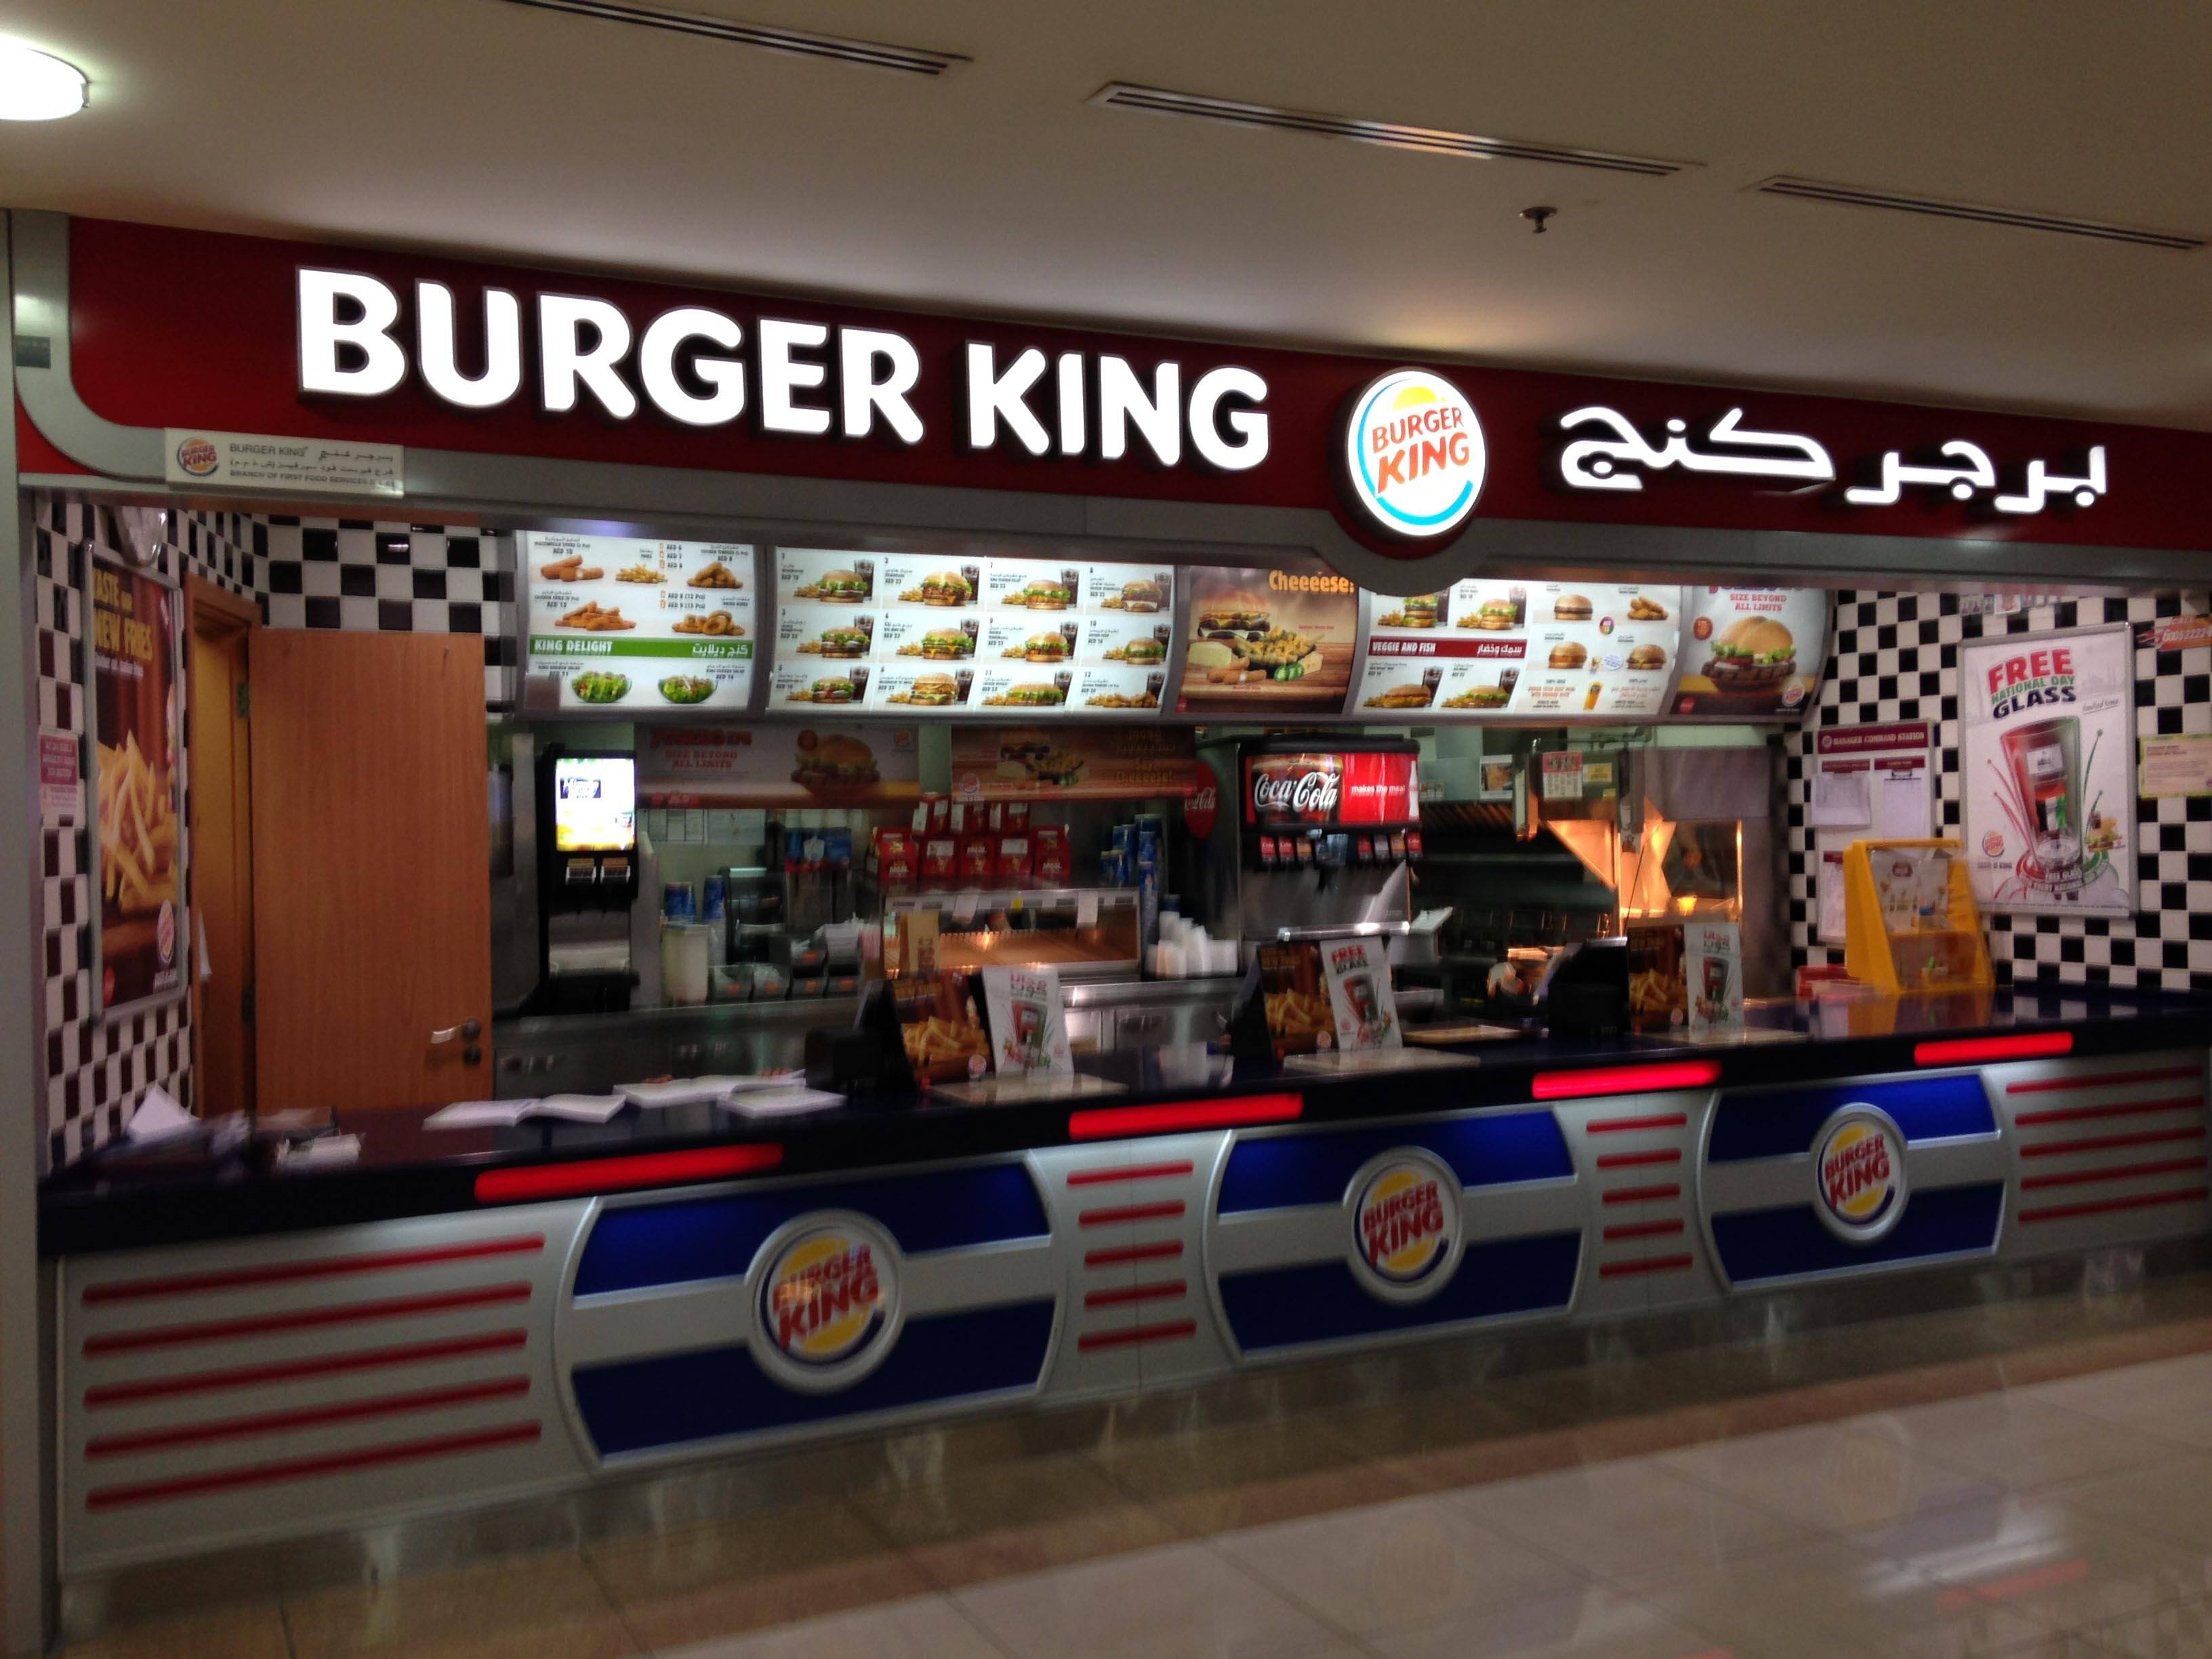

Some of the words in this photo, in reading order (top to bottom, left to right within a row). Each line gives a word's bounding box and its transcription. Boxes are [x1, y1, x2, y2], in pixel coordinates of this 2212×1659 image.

[299, 268, 924, 443] BURGER
[968, 342, 1269, 470] KING
[1372, 407, 1463, 453] BURGER
[182, 445, 215, 457] BURGER
[182, 451, 218, 468] KING
[229, 443, 276, 455] BURGER
[1378, 432, 1469, 493] KING
[1559, 406, 1835, 490] كنج
[1845, 440, 2107, 513] برجر
[1730, 593, 1749, 601] SIZE
[1751, 594, 1788, 602] BEYOND
[1735, 602, 1751, 611] ALL
[1754, 603, 1783, 612] LIMITS
[96, 609, 121, 652] NEW
[124, 617, 152, 661] FRIES
[534, 639, 563, 651] KING
[566, 640, 613, 653] DELIGHT
[1372, 641, 1399, 652] VEGGIE
[1401, 642, 1418, 653] AND
[1418, 642, 1437, 653] FISH
[1988, 648, 2074, 695] FREE
[1991, 678, 2047, 705] NATIONAL
[2051, 675, 2076, 686] DAY
[1992, 685, 2077, 718] GLASS
[1833, 735, 1863, 745] MANAGER
[1864, 733, 1897, 743] COMMAND
[1898, 731, 1925, 742] STATION
[693, 750, 738, 759] BEYOND
[695, 759, 733, 769] LIMITS
[1254, 771, 1340, 813] Coca-Cola
[1351, 784, 1375, 793] makes
[1376, 784, 1388, 793] the
[1389, 785, 1406, 793] meal
[1331, 944, 1366, 964] FREE
[1336, 960, 1368, 975] GLASS
[1825, 1133, 1884, 1182] BURGER
[1830, 1151, 1890, 1211] KING
[1364, 1180, 1438, 1235] BURGER
[1369, 1199, 1444, 1269] KING
[780, 1263, 880, 1352] KING
